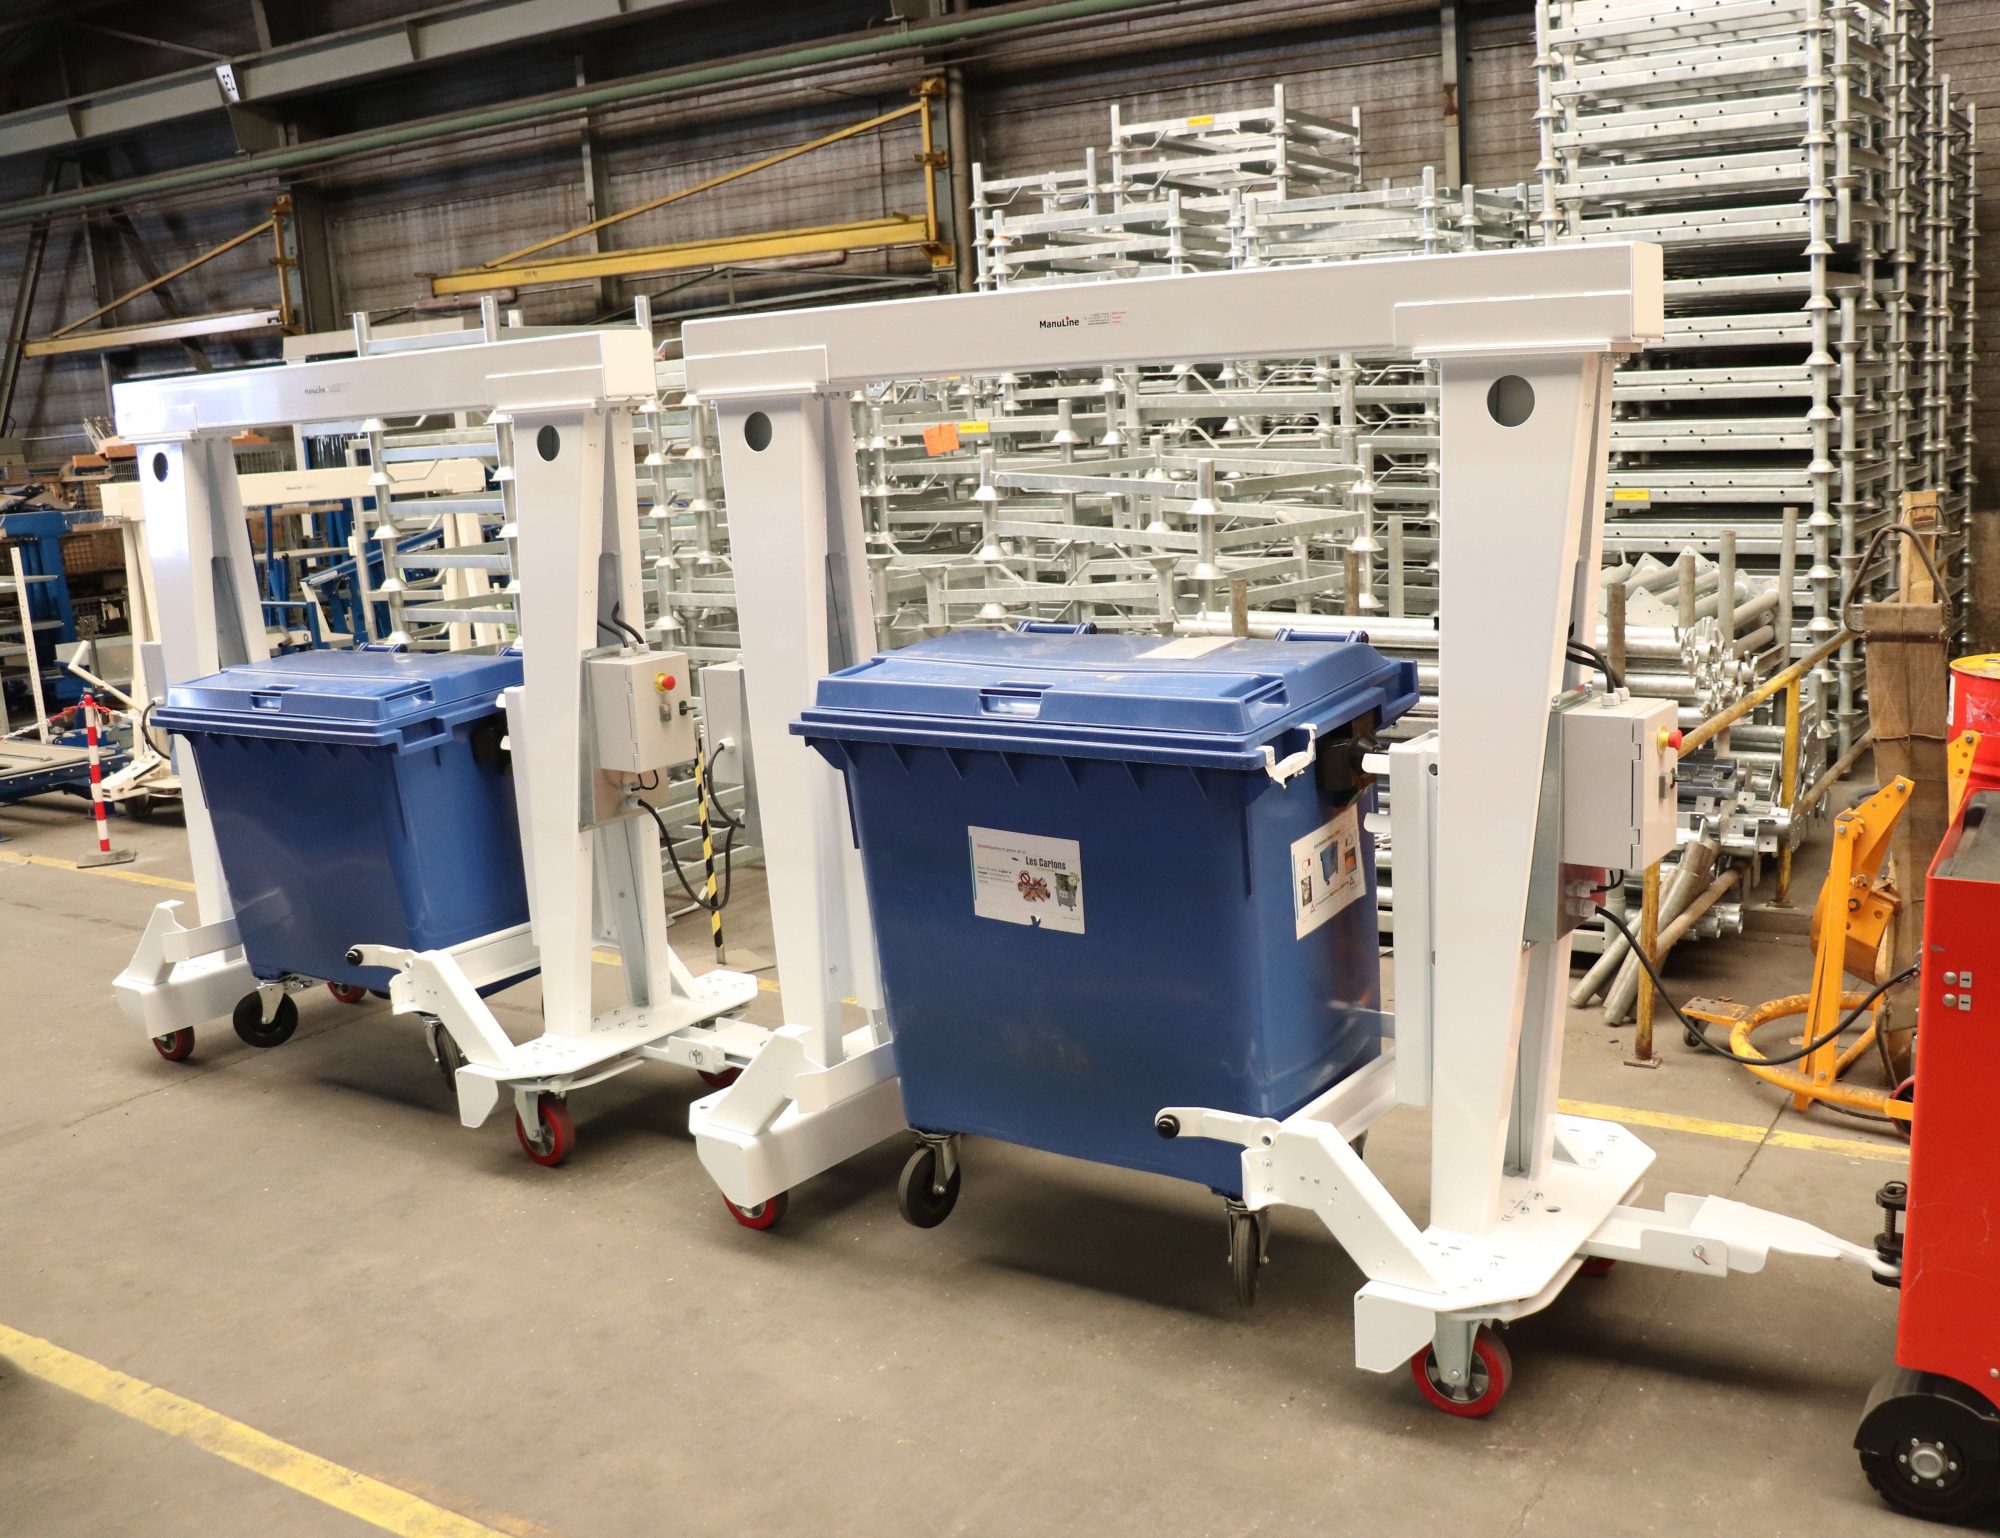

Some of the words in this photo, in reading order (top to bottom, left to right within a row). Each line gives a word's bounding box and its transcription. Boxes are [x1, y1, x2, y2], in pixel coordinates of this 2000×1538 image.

[222, 73, 236, 92] E2
[1039, 315, 1080, 329] ManuLine
[1025, 855, 1038, 867] Les
[1038, 857, 1067, 870] Cartons
